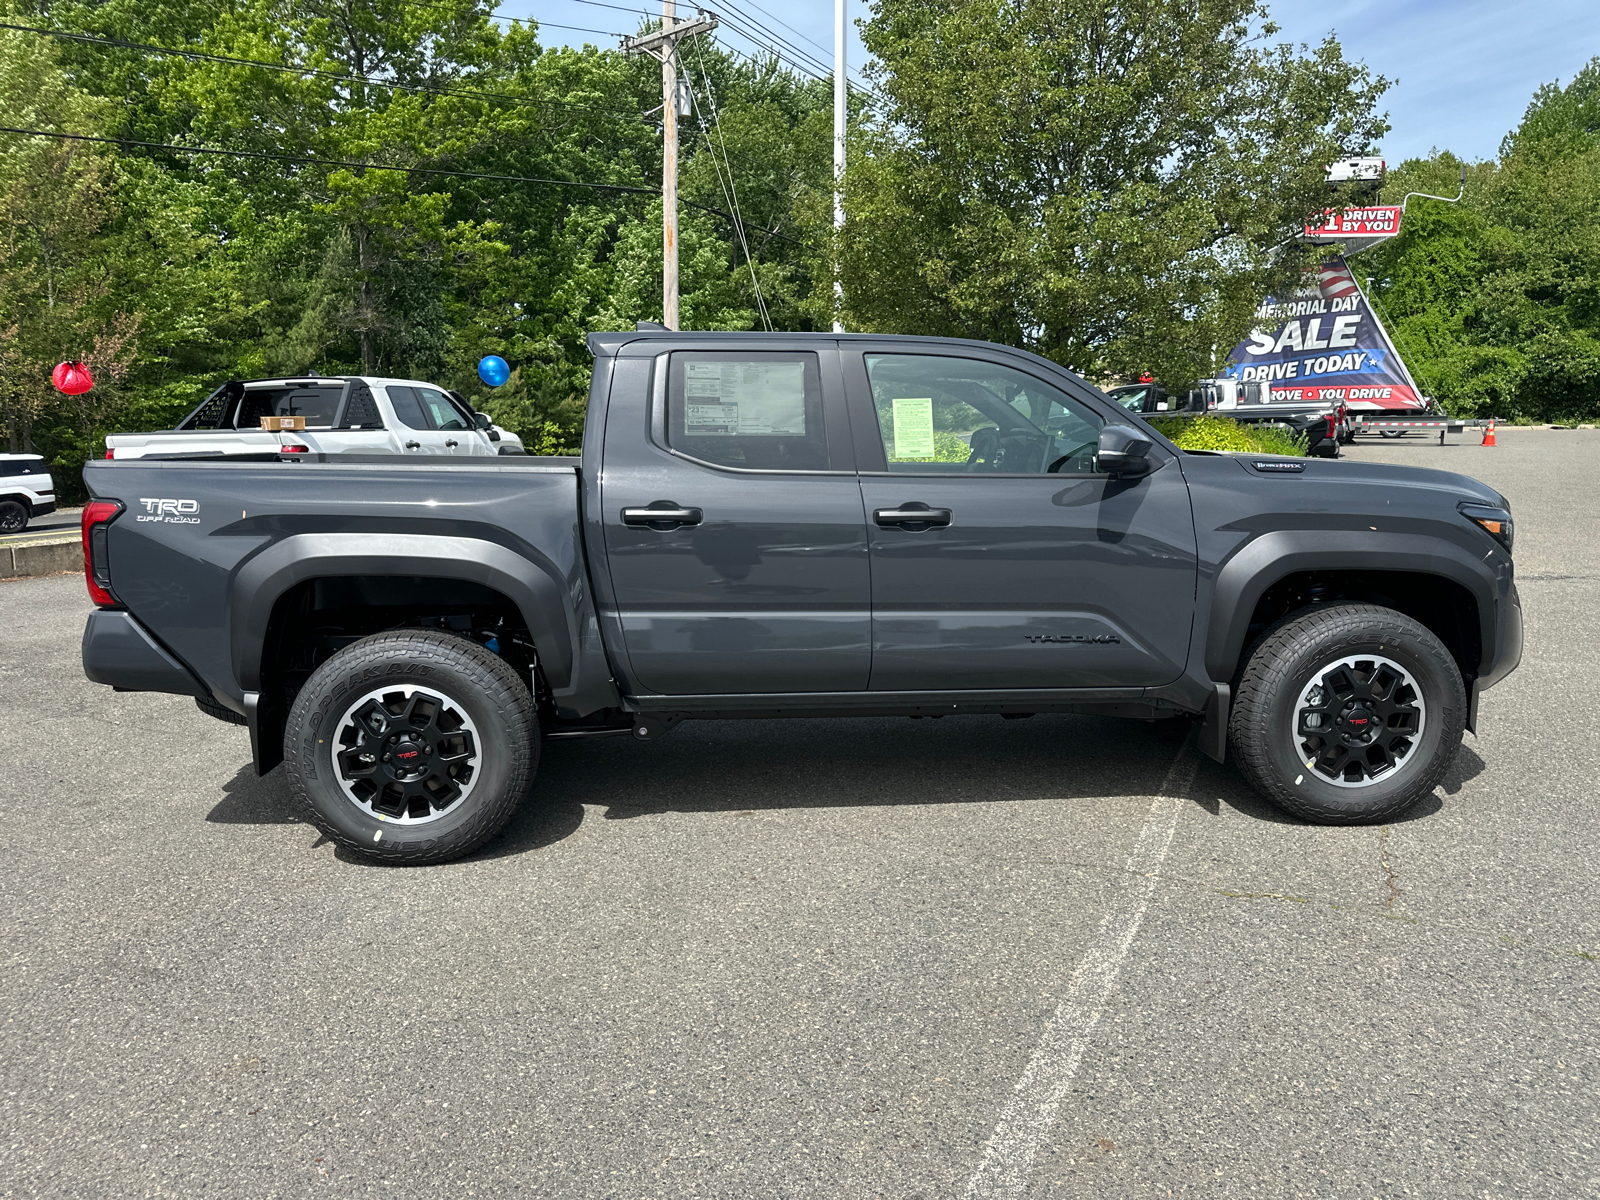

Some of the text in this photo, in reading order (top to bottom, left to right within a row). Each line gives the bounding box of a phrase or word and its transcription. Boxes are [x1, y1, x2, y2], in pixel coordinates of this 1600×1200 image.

[1343, 210, 1395, 221] DRIVEN
[1342, 221, 1394, 231] BY YOU
[1331, 296, 1360, 312] DAY
[1245, 314, 1362, 356] SALE
[1243, 352, 1367, 382] DRIVE TODAY
[1270, 388, 1392, 400] ROVE YOU DRIVE
[139, 498, 200, 516] TRD
[164, 516, 200, 524] ROAD
[1025, 634, 1121, 644] TACOMA
[303, 664, 382, 780] WILDPEAK
[386, 662, 437, 676] A/T
[397, 751, 418, 759] TRD
